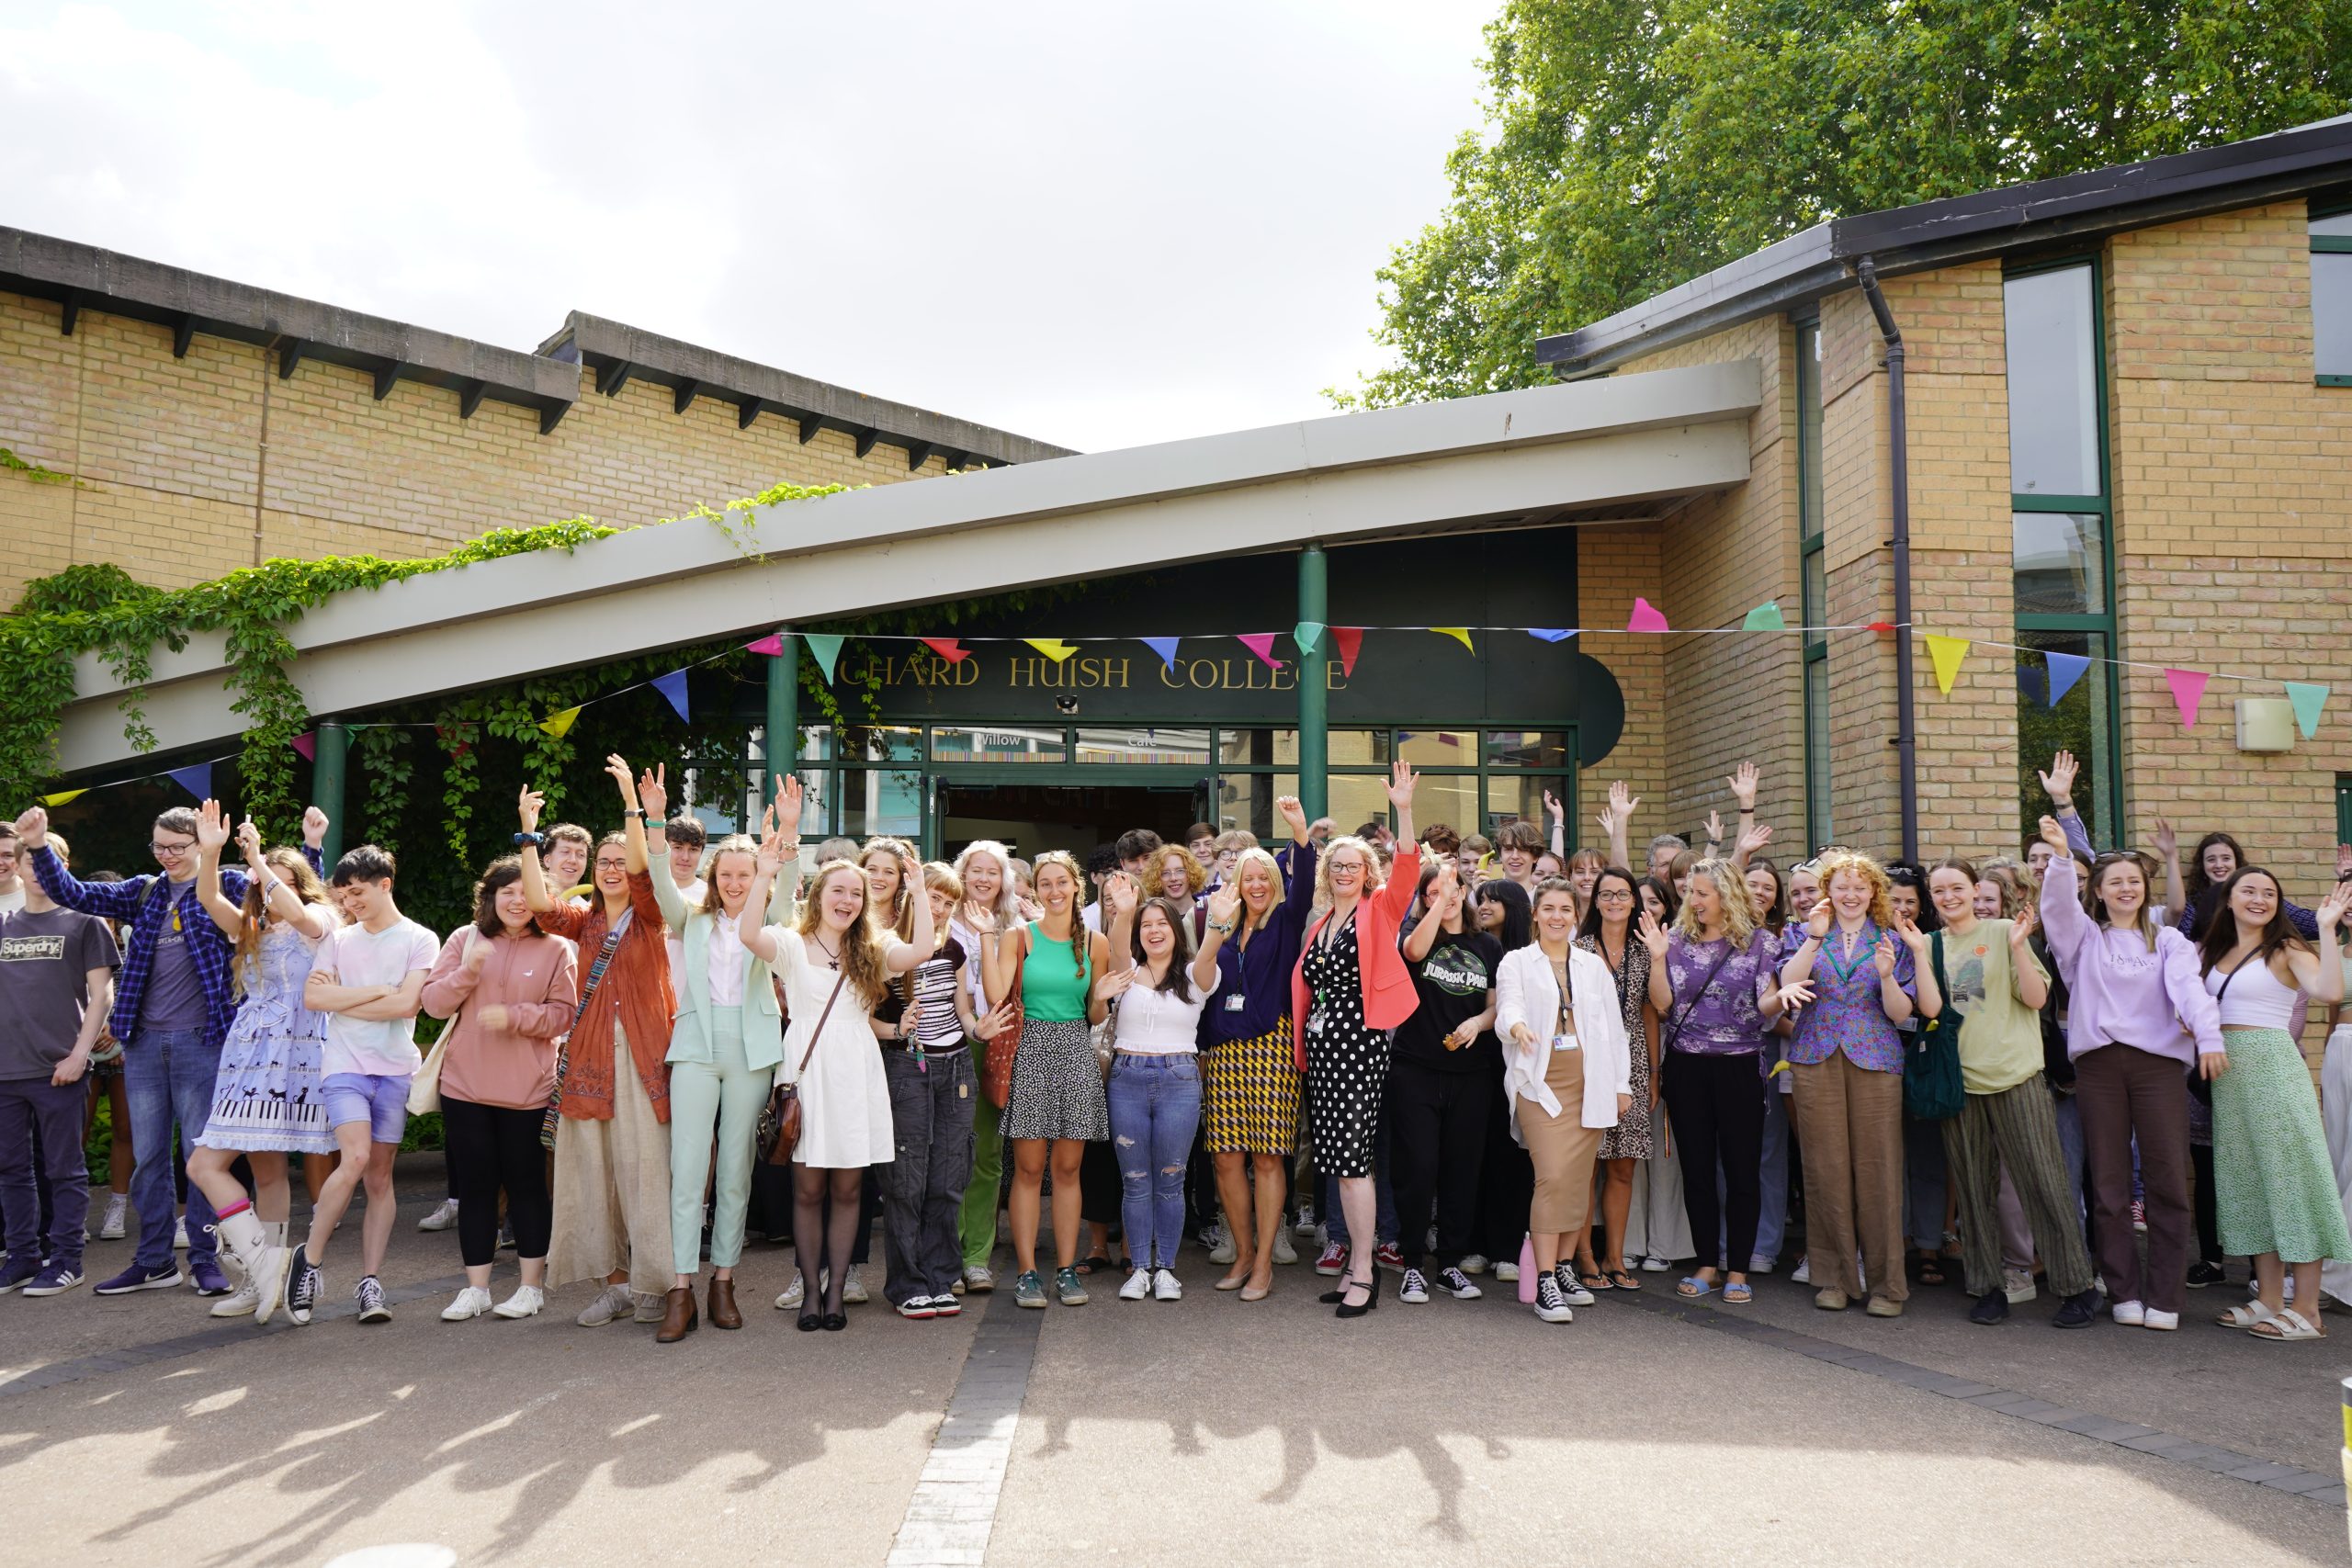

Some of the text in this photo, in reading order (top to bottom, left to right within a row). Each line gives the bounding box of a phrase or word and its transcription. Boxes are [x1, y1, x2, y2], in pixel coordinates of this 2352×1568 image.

[840, 656, 1348, 690] CHARD HUISH COLLEE
[976, 733, 1020, 745] Willow
[1423, 962, 1465, 984] JURASSIC
